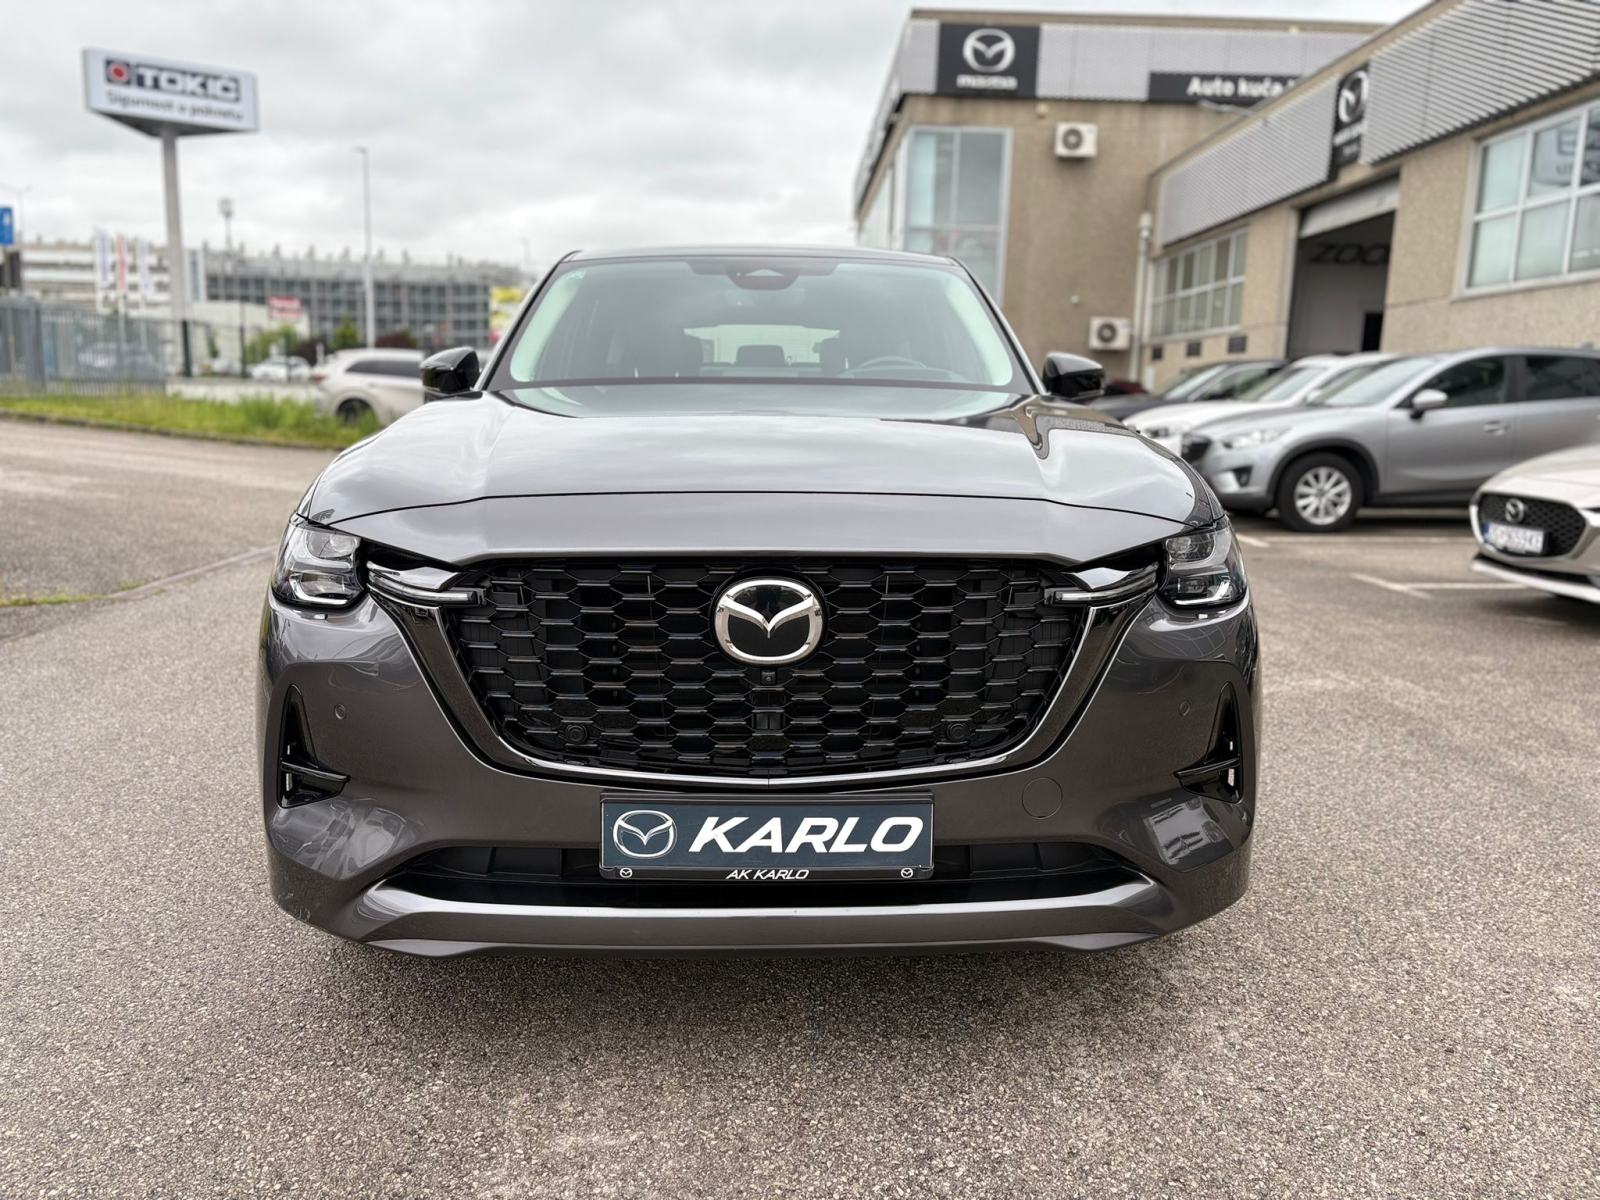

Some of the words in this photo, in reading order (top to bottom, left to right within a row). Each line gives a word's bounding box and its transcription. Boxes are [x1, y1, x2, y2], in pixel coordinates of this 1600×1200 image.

[1186, 75, 1235, 97] Auto
[688, 816, 924, 853] KARLO
[725, 869, 752, 880] AK
[753, 869, 809, 880] KARLO
